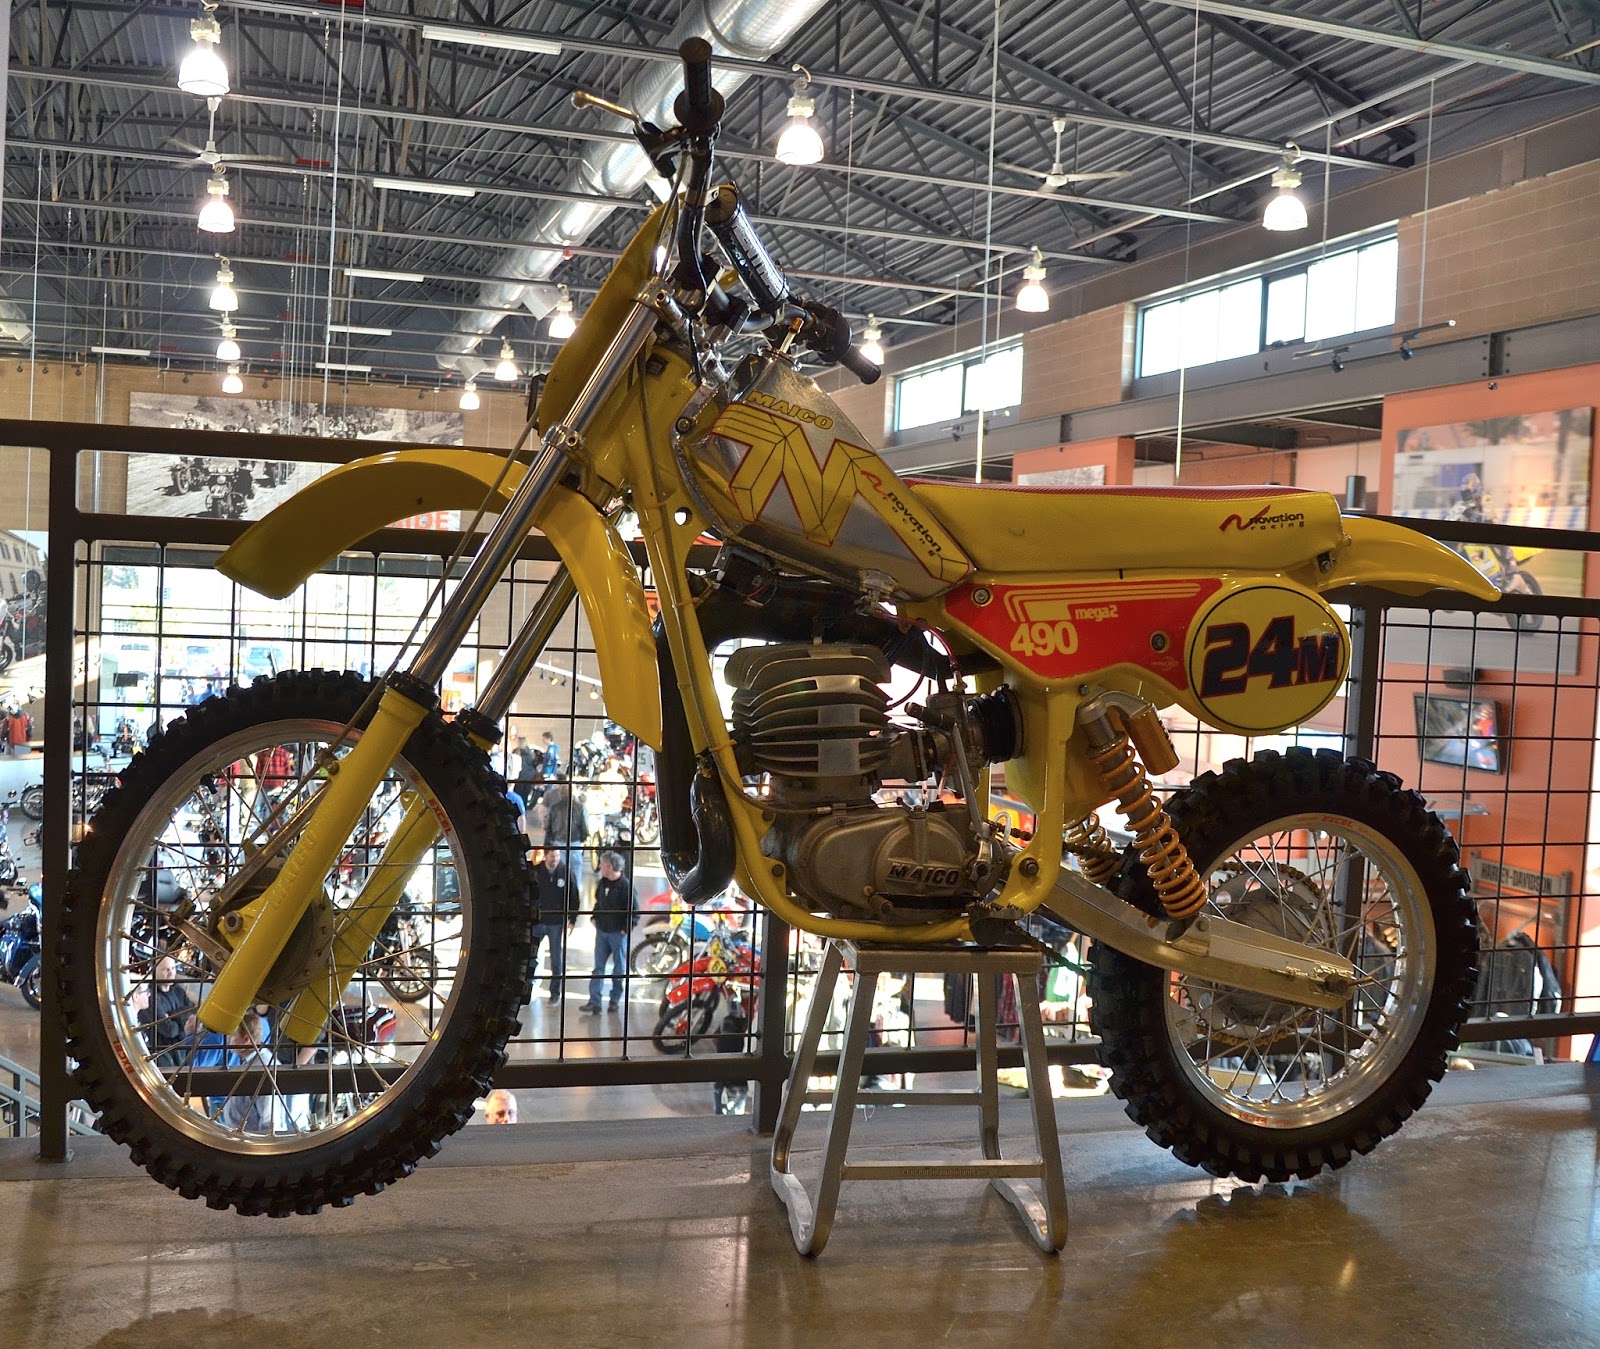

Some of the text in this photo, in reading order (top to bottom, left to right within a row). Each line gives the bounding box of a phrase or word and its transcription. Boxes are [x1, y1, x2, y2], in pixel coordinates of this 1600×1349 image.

[746, 390, 833, 430] MAICO
[883, 497, 935, 556] racing
[887, 492, 942, 552] novation
[1251, 521, 1305, 530] racing
[1075, 604, 1118, 622] mega2
[1010, 621, 1078, 656] 490
[887, 862, 960, 886] MAICO
